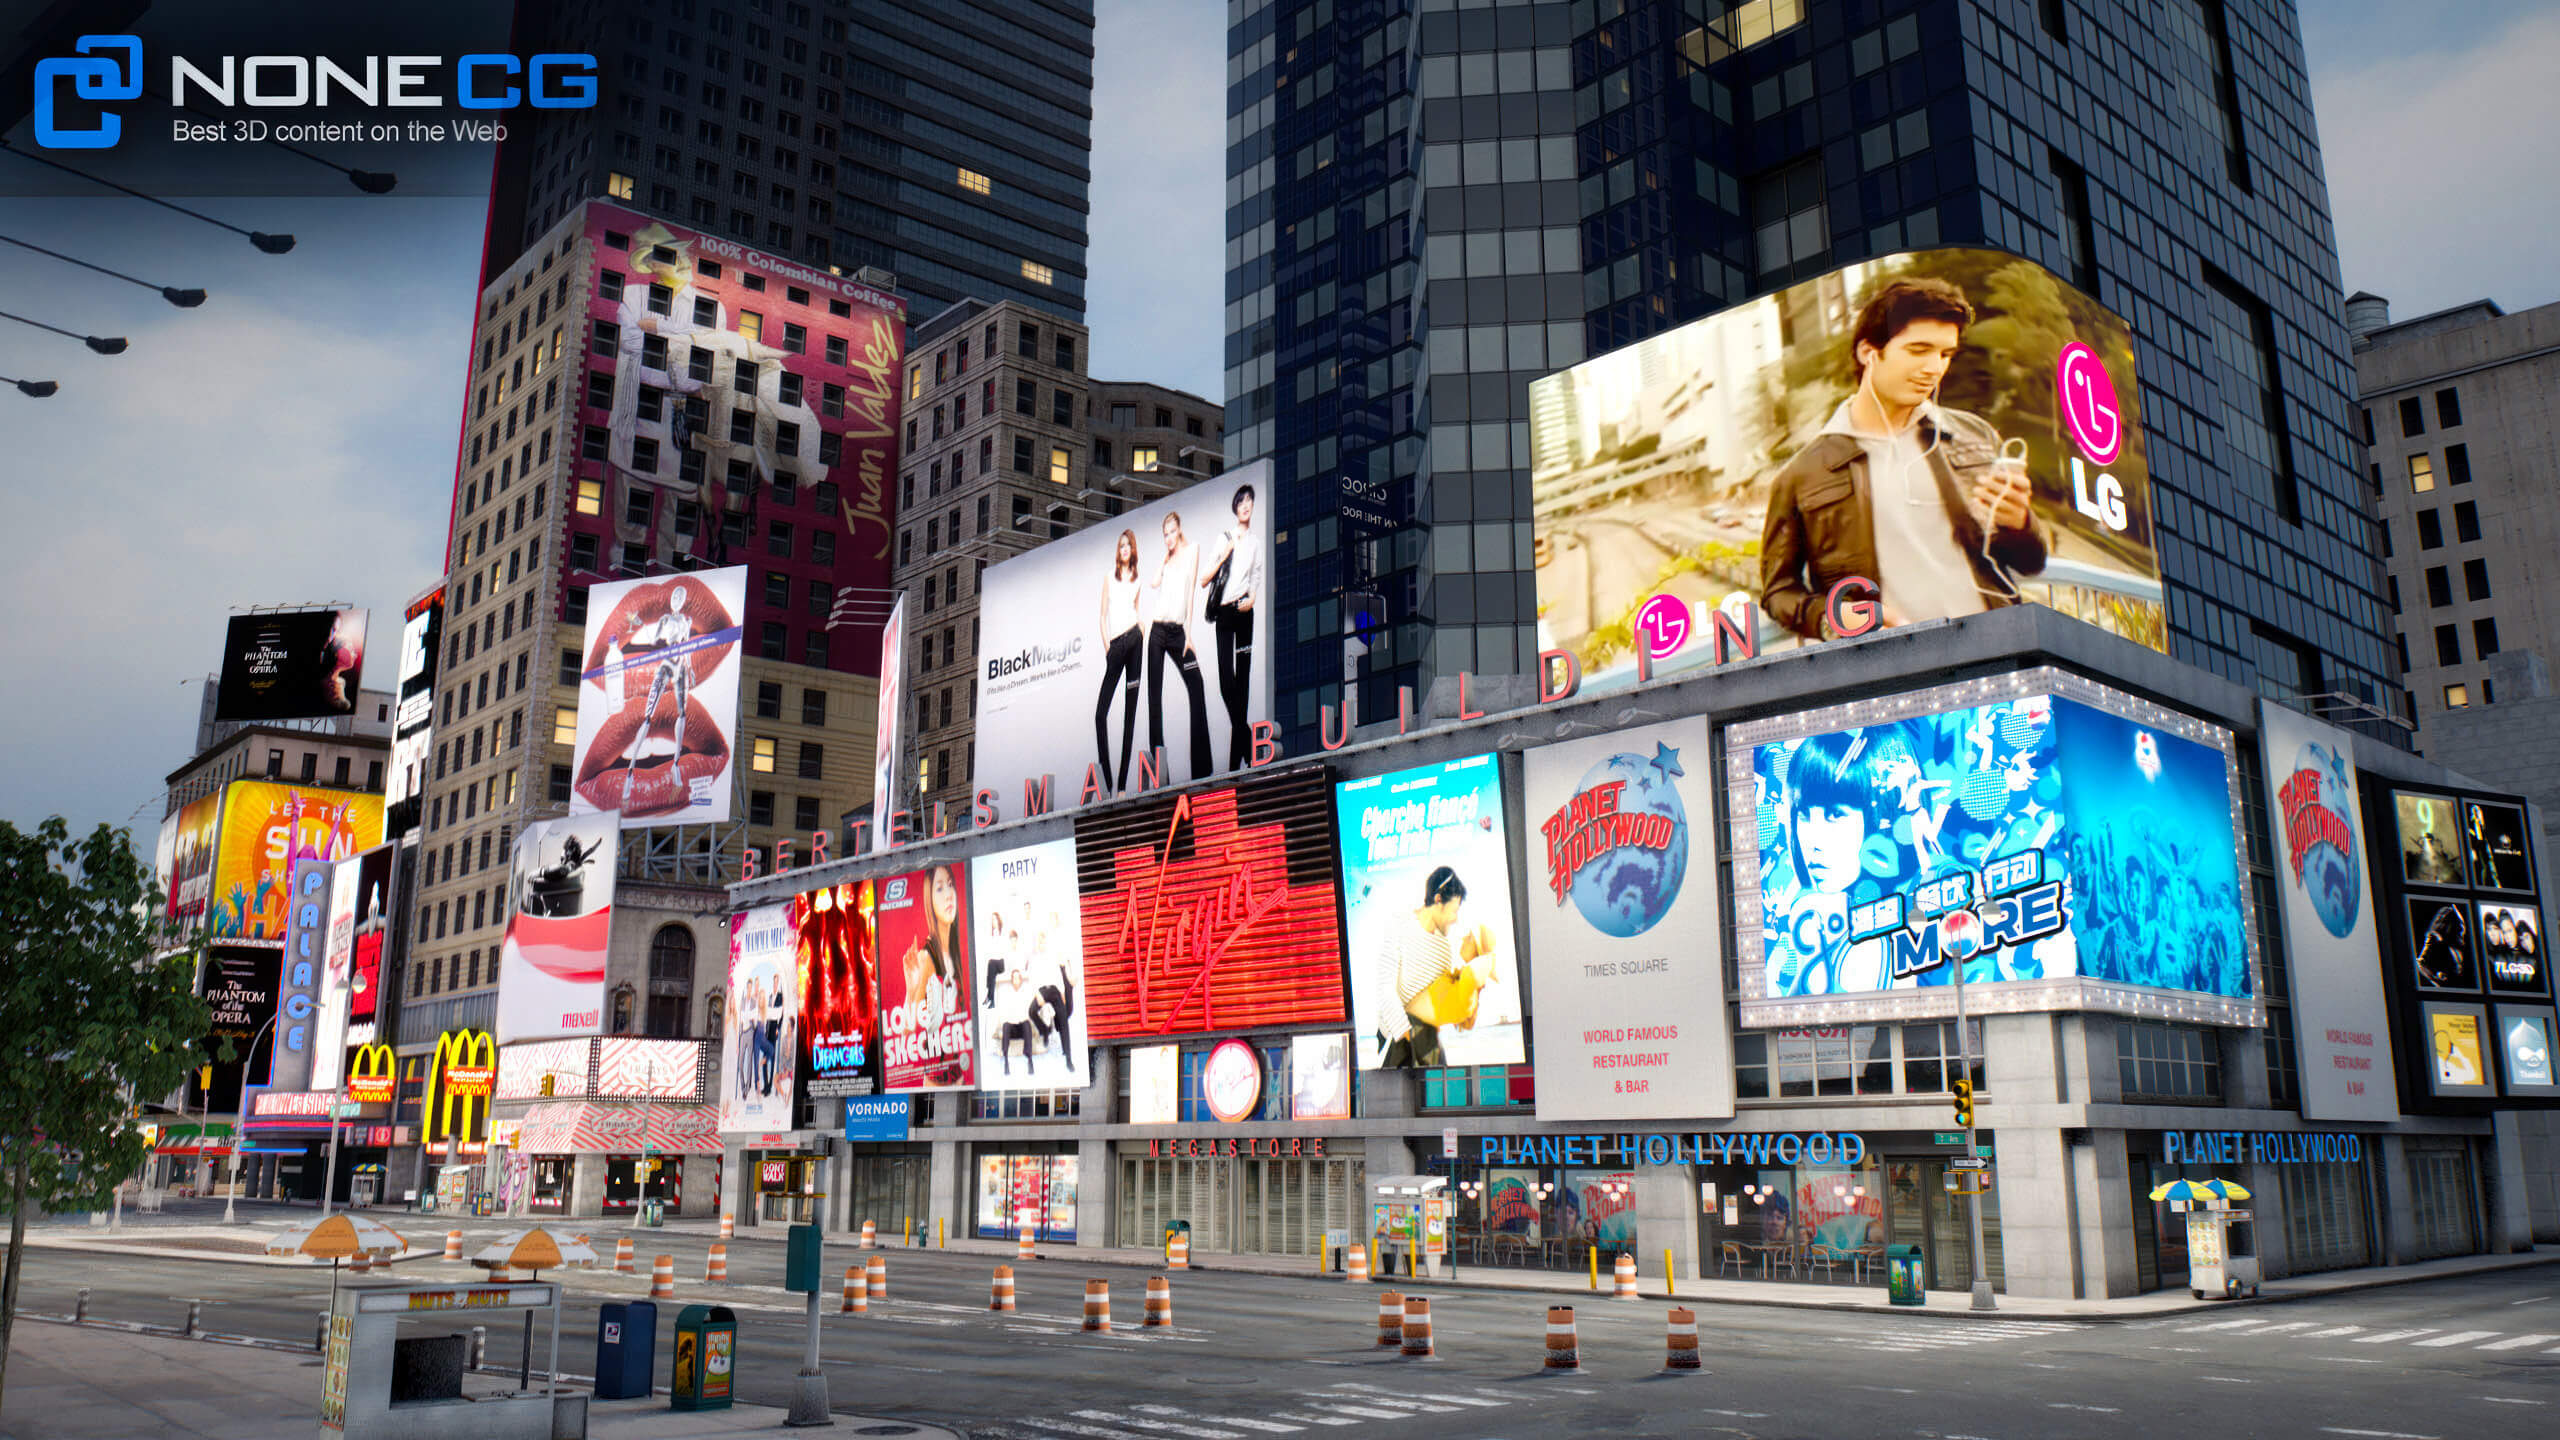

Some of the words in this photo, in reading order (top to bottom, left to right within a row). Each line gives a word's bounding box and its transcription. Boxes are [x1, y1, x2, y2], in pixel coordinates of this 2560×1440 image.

[700, 236, 742, 262] 100%
[747, 250, 838, 292] Colombian
[845, 314, 899, 439] Valdez
[842, 449, 892, 560] Juan
[2071, 457, 2128, 531] LG
[988, 637, 1082, 680] BlackMagic
[1251, 576, 1883, 768] BUILDING
[269, 800, 307, 817] LET
[319, 806, 357, 823] THE
[2278, 768, 2322, 840] PLANET
[1541, 779, 1628, 873] PLANET
[265, 826, 353, 860] SUN
[1549, 812, 1676, 907] HOLLYWOOD
[2290, 803, 2351, 890] HOLLYWOOD
[1002, 858, 1038, 880] PARTY
[287, 871, 324, 1051] PALACE
[1583, 962, 1617, 978] TIMES
[1620, 957, 1669, 975] SQUARE
[206, 989, 266, 1003] PHANTOM
[211, 1011, 251, 1024] OPERA
[561, 1008, 599, 1030] maxell
[884, 1018, 974, 1067] SKECHERS
[1583, 1028, 1625, 1044] WORLD
[1627, 1025, 1678, 1041] FAMOUS
[2326, 1029, 2347, 1044] WORLD
[2348, 1031, 2373, 1047] FAMOUS
[1592, 1052, 1670, 1069] RESTAURANT
[2333, 1055, 2371, 1071] RESTAURANT
[1614, 1080, 1623, 1094] &
[1625, 1079, 1649, 1093] BAR
[847, 1101, 908, 1116] VORNADO
[1149, 1137, 1326, 1158] MEGASTORE
[1481, 1135, 1606, 1165] PLANET
[1620, 1131, 1867, 1167] HOLLYWOOD
[2162, 1131, 2245, 1164] PLANET
[2251, 1132, 2361, 1163] HOLLYWOOD
[409, 1291, 455, 1309] NUTS
[468, 1289, 510, 1307] NUTS
